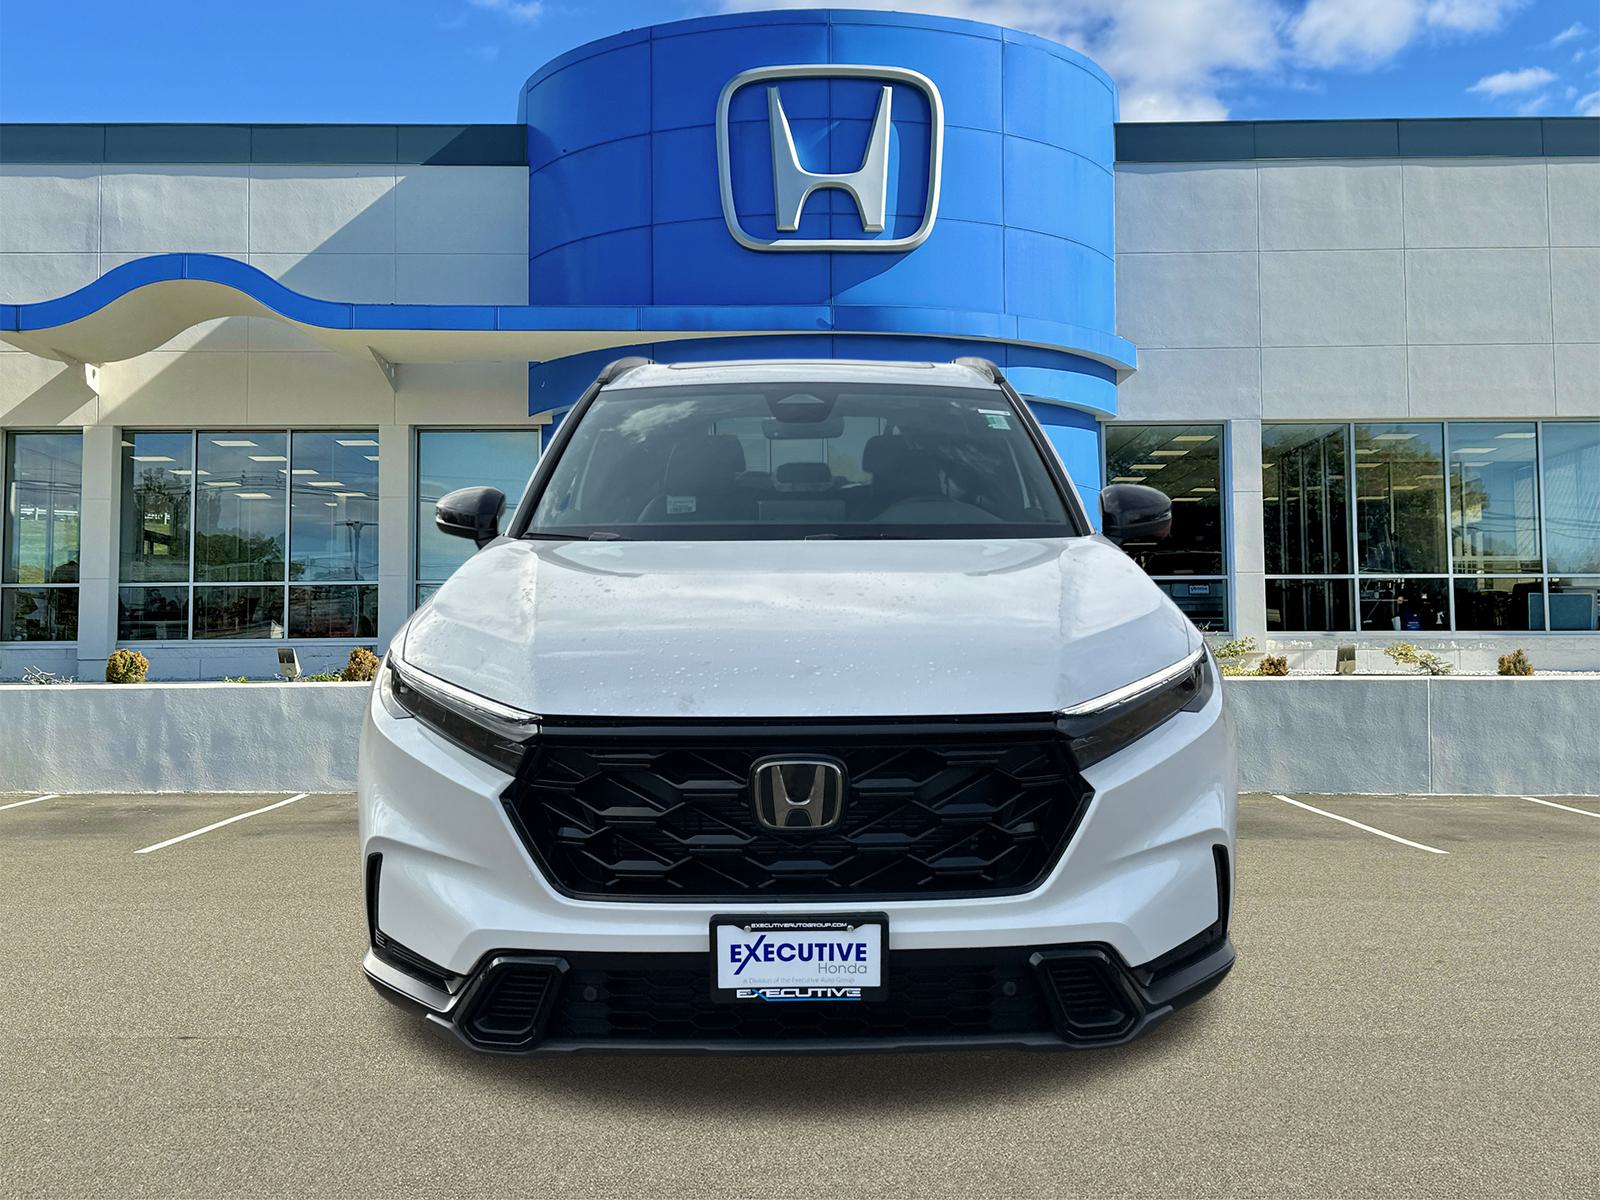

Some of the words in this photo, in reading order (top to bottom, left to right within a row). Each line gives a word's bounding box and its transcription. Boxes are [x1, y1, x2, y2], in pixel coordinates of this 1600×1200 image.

[730, 935, 867, 975] EXECUTIVE
[818, 963, 867, 974] Honda
[736, 988, 862, 999] EXECUTIVE
